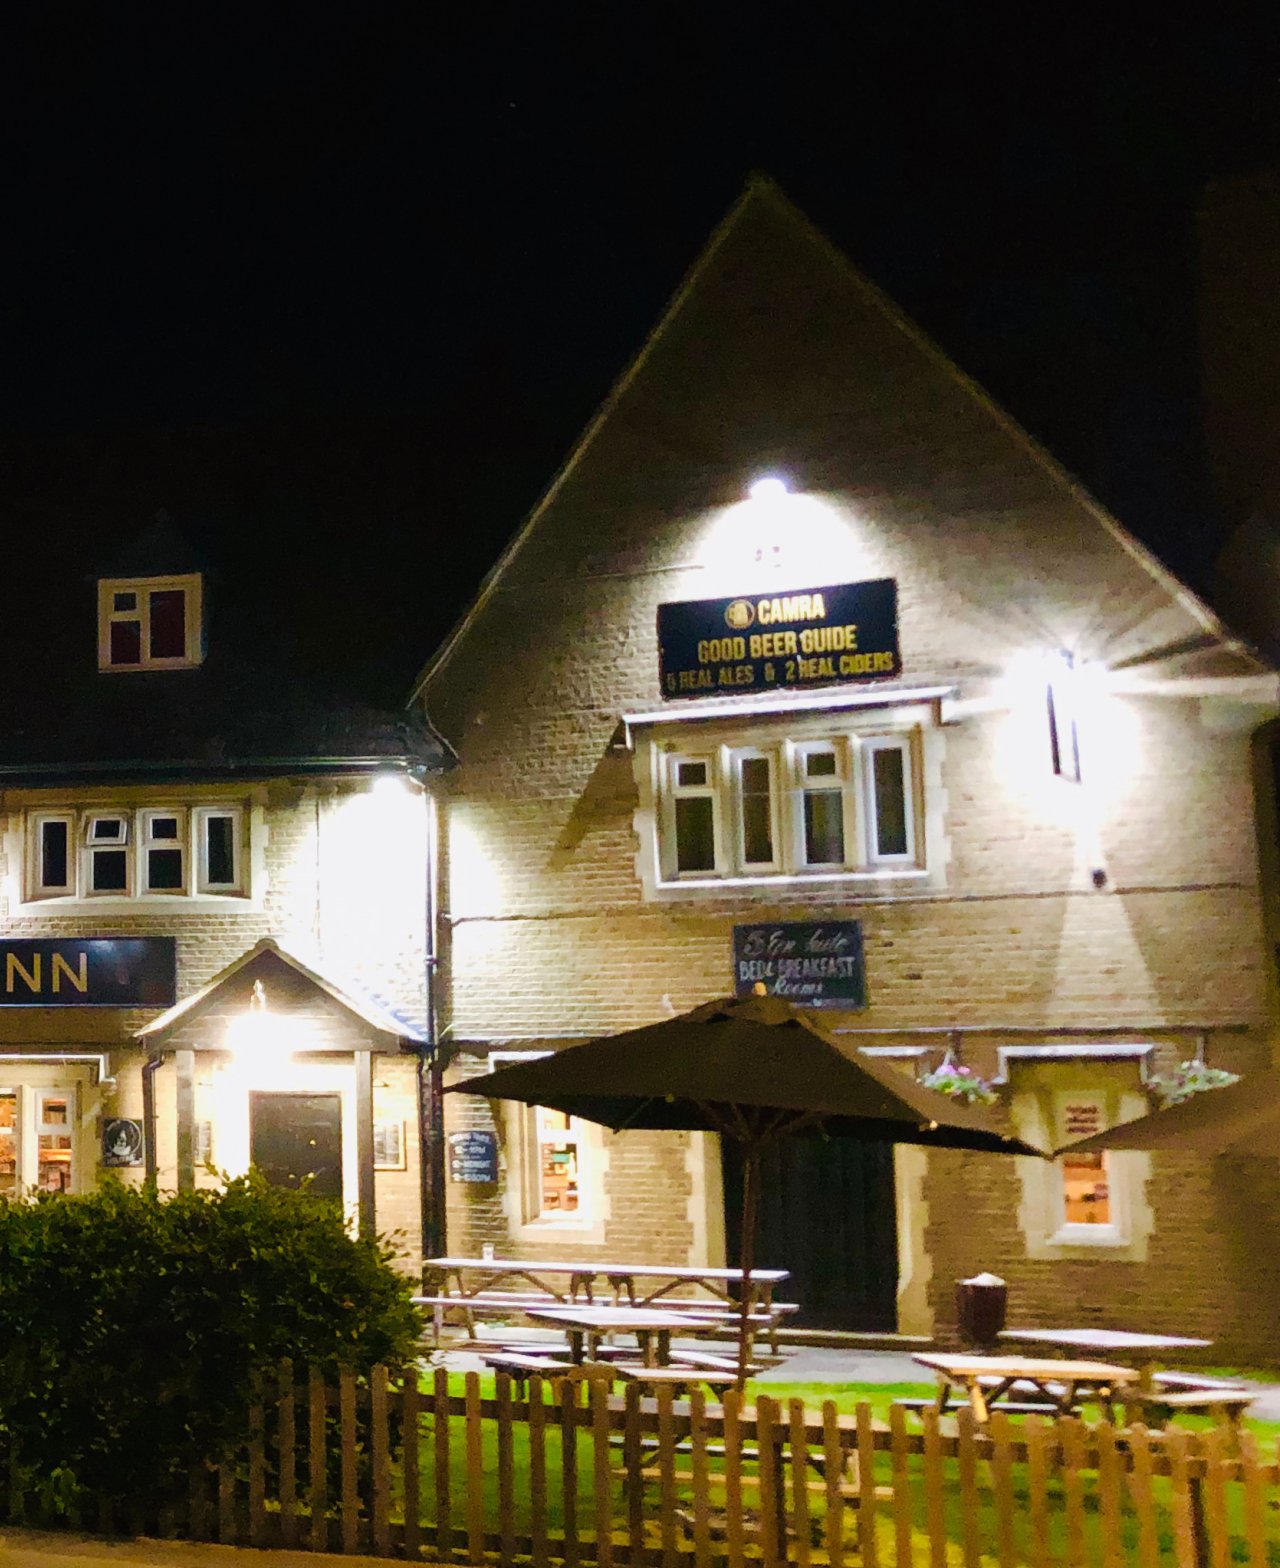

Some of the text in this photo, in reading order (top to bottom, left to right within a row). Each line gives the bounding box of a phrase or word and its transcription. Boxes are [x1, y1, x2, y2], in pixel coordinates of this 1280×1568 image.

[757, 592, 826, 626] CAMRA
[697, 624, 858, 664] GOOD BEER GUIDE
[679, 669, 713, 690] REAL
[718, 664, 754, 686] ALES
[784, 660, 796, 681] 2
[798, 656, 836, 679] REAL
[839, 650, 894, 676] CIDERS
[739, 960, 765, 982] BED
[777, 956, 856, 979] BREAKFAST
